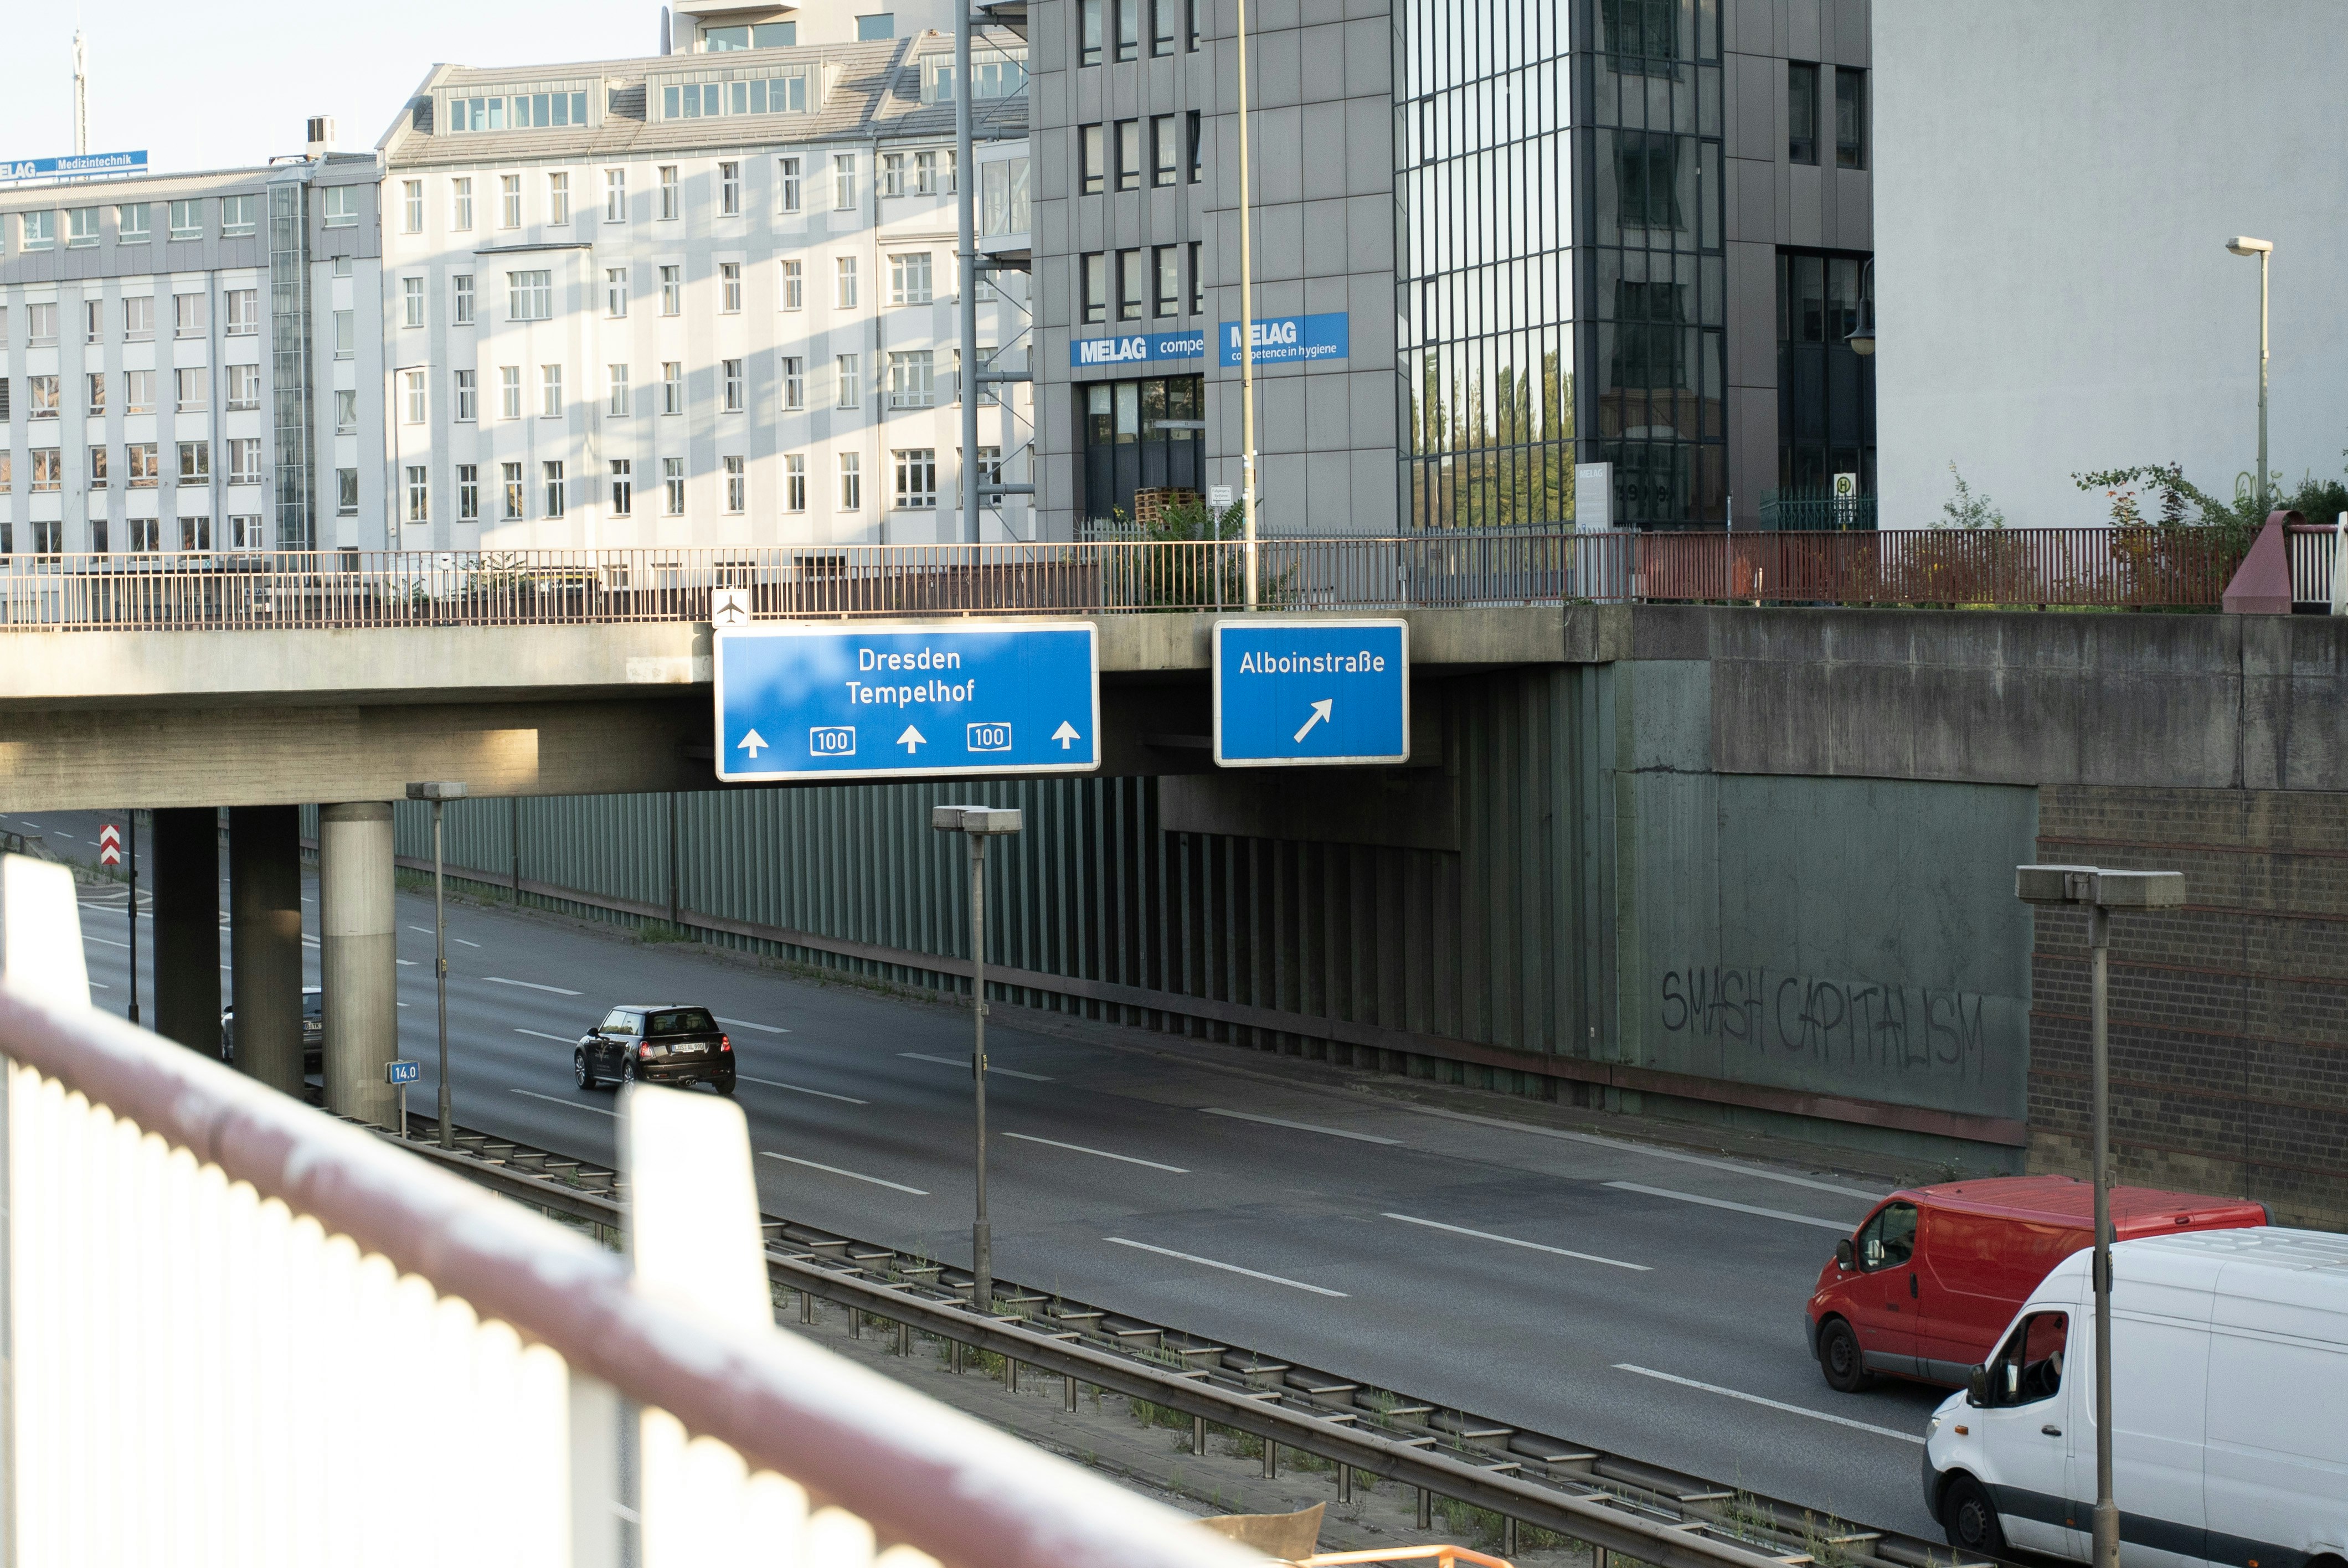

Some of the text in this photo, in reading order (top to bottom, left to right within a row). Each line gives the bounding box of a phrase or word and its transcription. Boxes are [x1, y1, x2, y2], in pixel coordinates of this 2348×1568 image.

[58, 154, 132, 169] Medizintechnik
[1231, 321, 1296, 348] MELAG
[1080, 337, 1203, 363] MELAG compe
[1232, 344, 1337, 362] copetence in hygiene
[1579, 468, 1603, 478] MELAG
[1840, 481, 1847, 490] H
[859, 647, 960, 671] Dresden
[1239, 650, 1385, 673] Alboinstraße
[846, 679, 975, 708] Tempelhof
[818, 733, 847, 751] 100
[975, 729, 1003, 746] 100
[1662, 966, 1985, 1077] SMASH CAPITALISM
